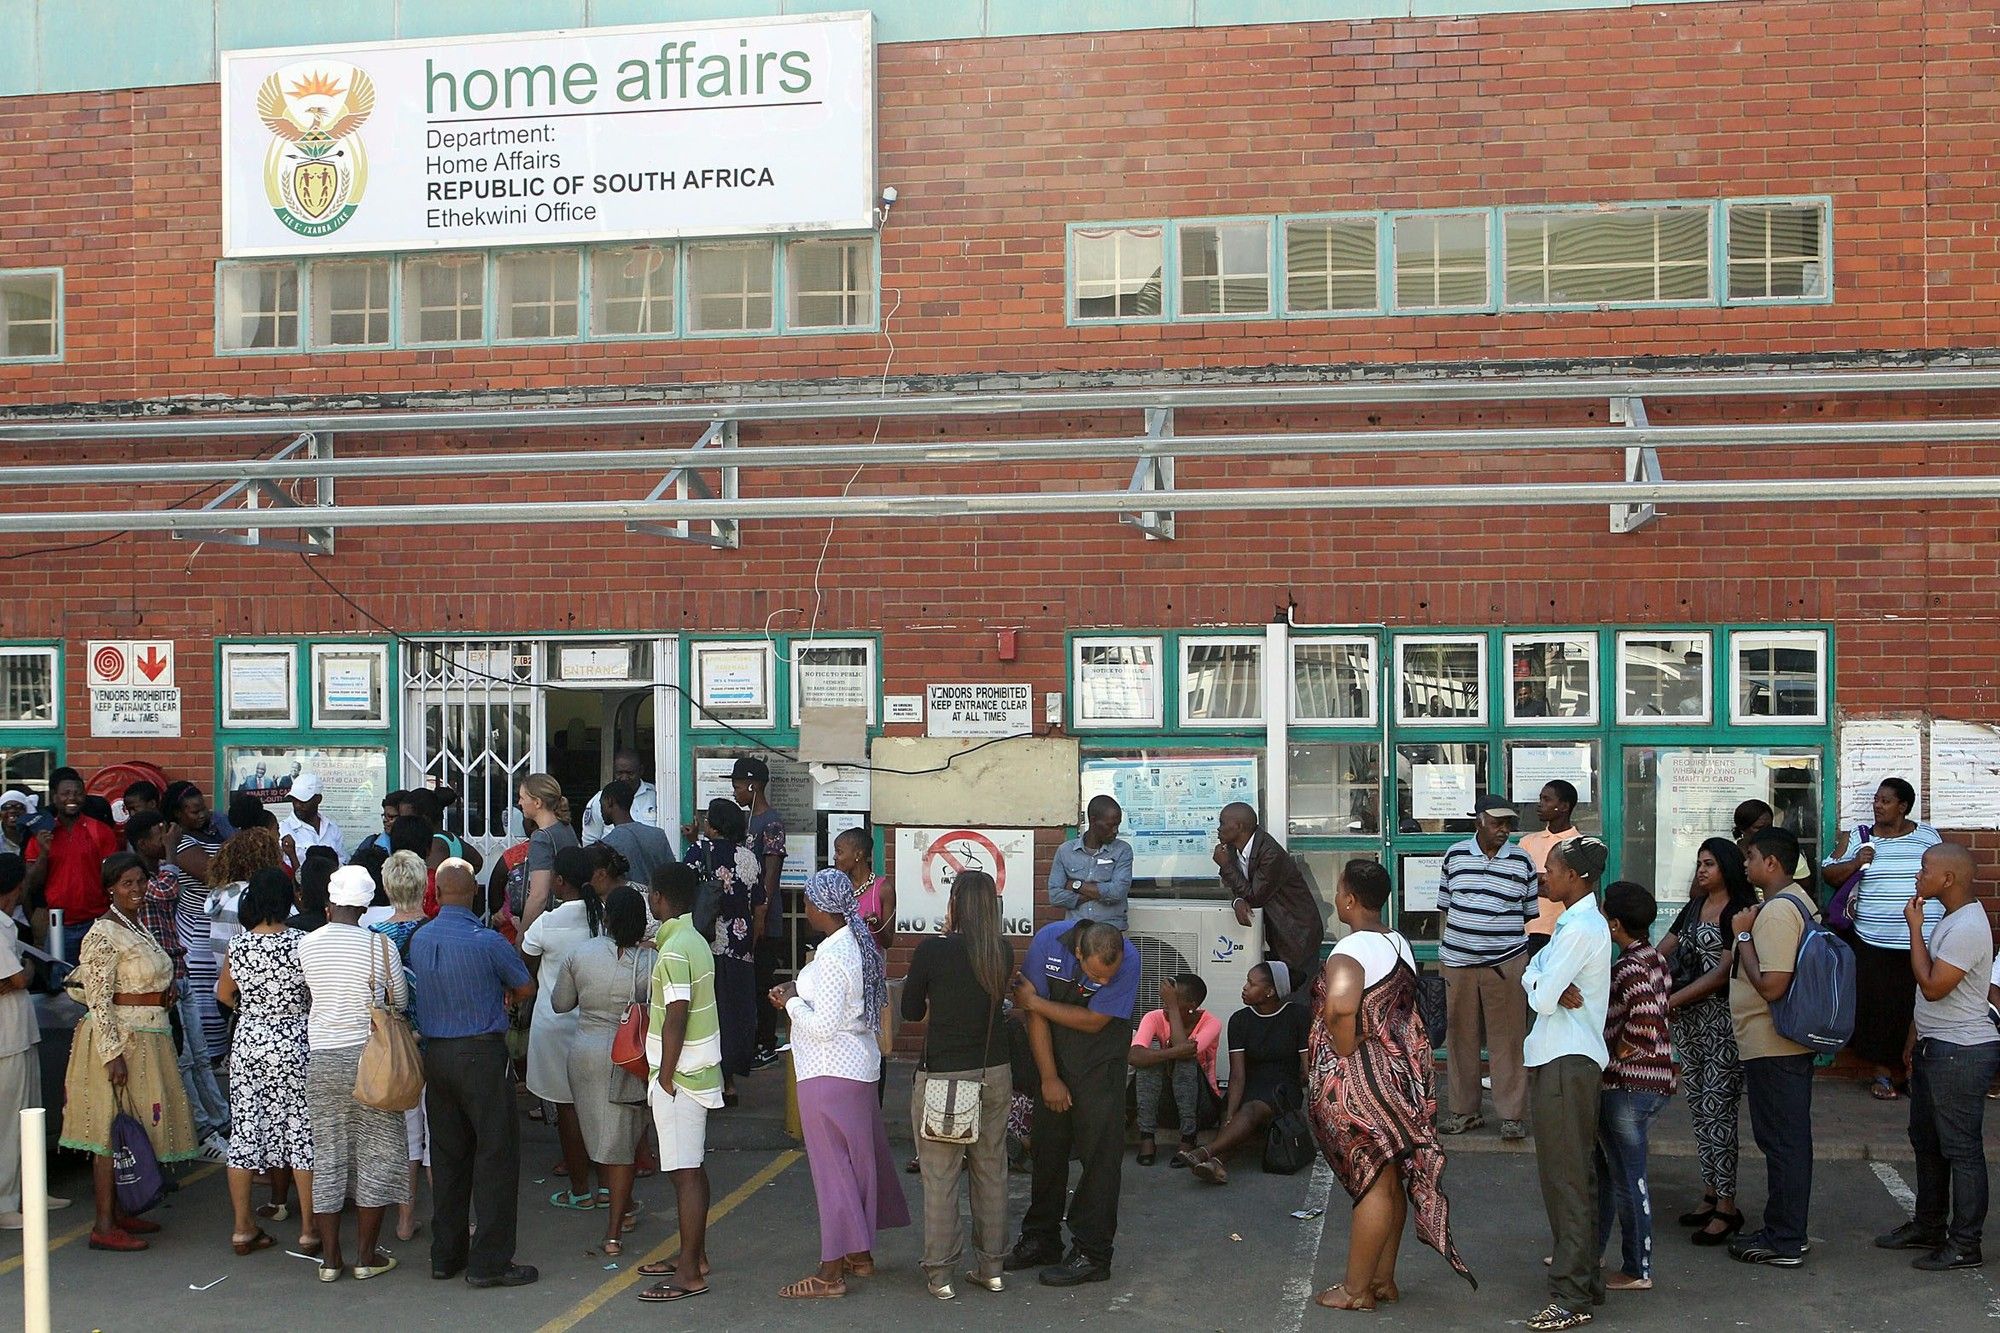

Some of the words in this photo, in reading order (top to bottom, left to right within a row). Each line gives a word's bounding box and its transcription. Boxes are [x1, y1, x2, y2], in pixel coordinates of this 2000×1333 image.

[426, 59, 597, 113] home
[616, 39, 812, 102] affairs
[427, 124, 555, 151] Department:
[426, 155, 488, 175] Home
[494, 150, 561, 172] Affairs
[427, 177, 545, 201] REPUBLIC
[553, 176, 585, 196] OF
[593, 171, 676, 194] SOUTH
[683, 167, 775, 190] AFRICA
[427, 203, 528, 228] Ethekwini
[535, 202, 597, 223] Office
[470, 652, 497, 662] EXT
[564, 665, 627, 675] ENTRANCE
[94, 690, 130, 701] VENDORS
[132, 690, 177, 701] PROHIBITED
[976, 687, 1027, 699] PROHIBITED
[94, 702, 112, 712] KEEP
[115, 702, 151, 712] ENTRANCE
[154, 702, 177, 712] CLEAR
[931, 700, 951, 710] KEEP
[955, 700, 998, 710] ENTRANCE
[1001, 700, 1027, 710] CLEAR
[112, 713, 120, 722] AT
[123, 713, 136, 722] ALL
[139, 713, 159, 722] TIMES
[952, 711, 962, 721] AT
[965, 711, 980, 721] ALL
[984, 711, 1007, 721] TIMES
[1657, 907, 1683, 917] sspo
